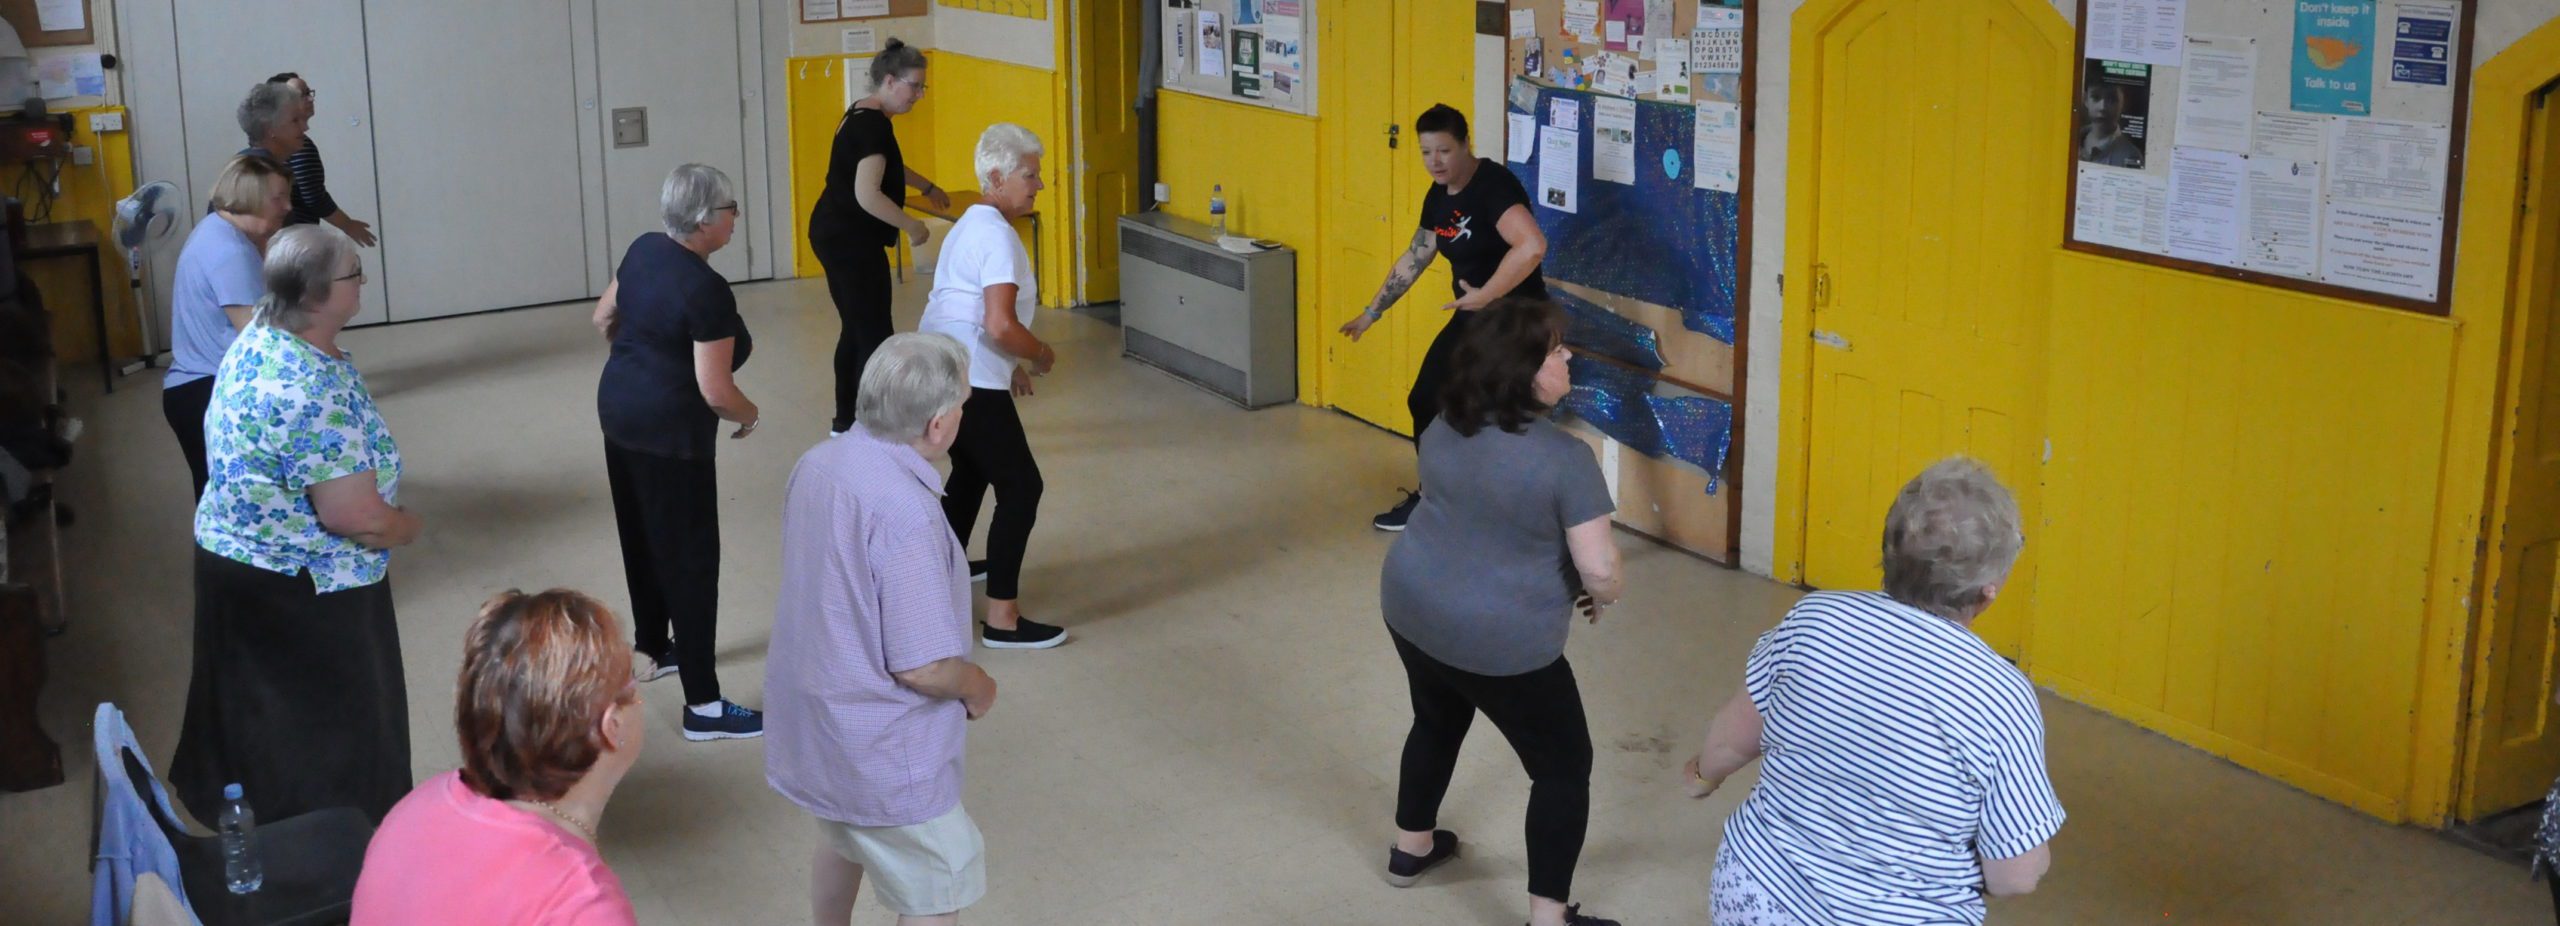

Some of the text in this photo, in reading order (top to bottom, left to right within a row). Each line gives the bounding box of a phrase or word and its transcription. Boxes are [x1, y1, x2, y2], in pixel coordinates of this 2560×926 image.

[2300, 2, 2370, 16] Don't keep it
[2317, 16, 2350, 28] inside
[2304, 77, 2356, 92] Talk to us
